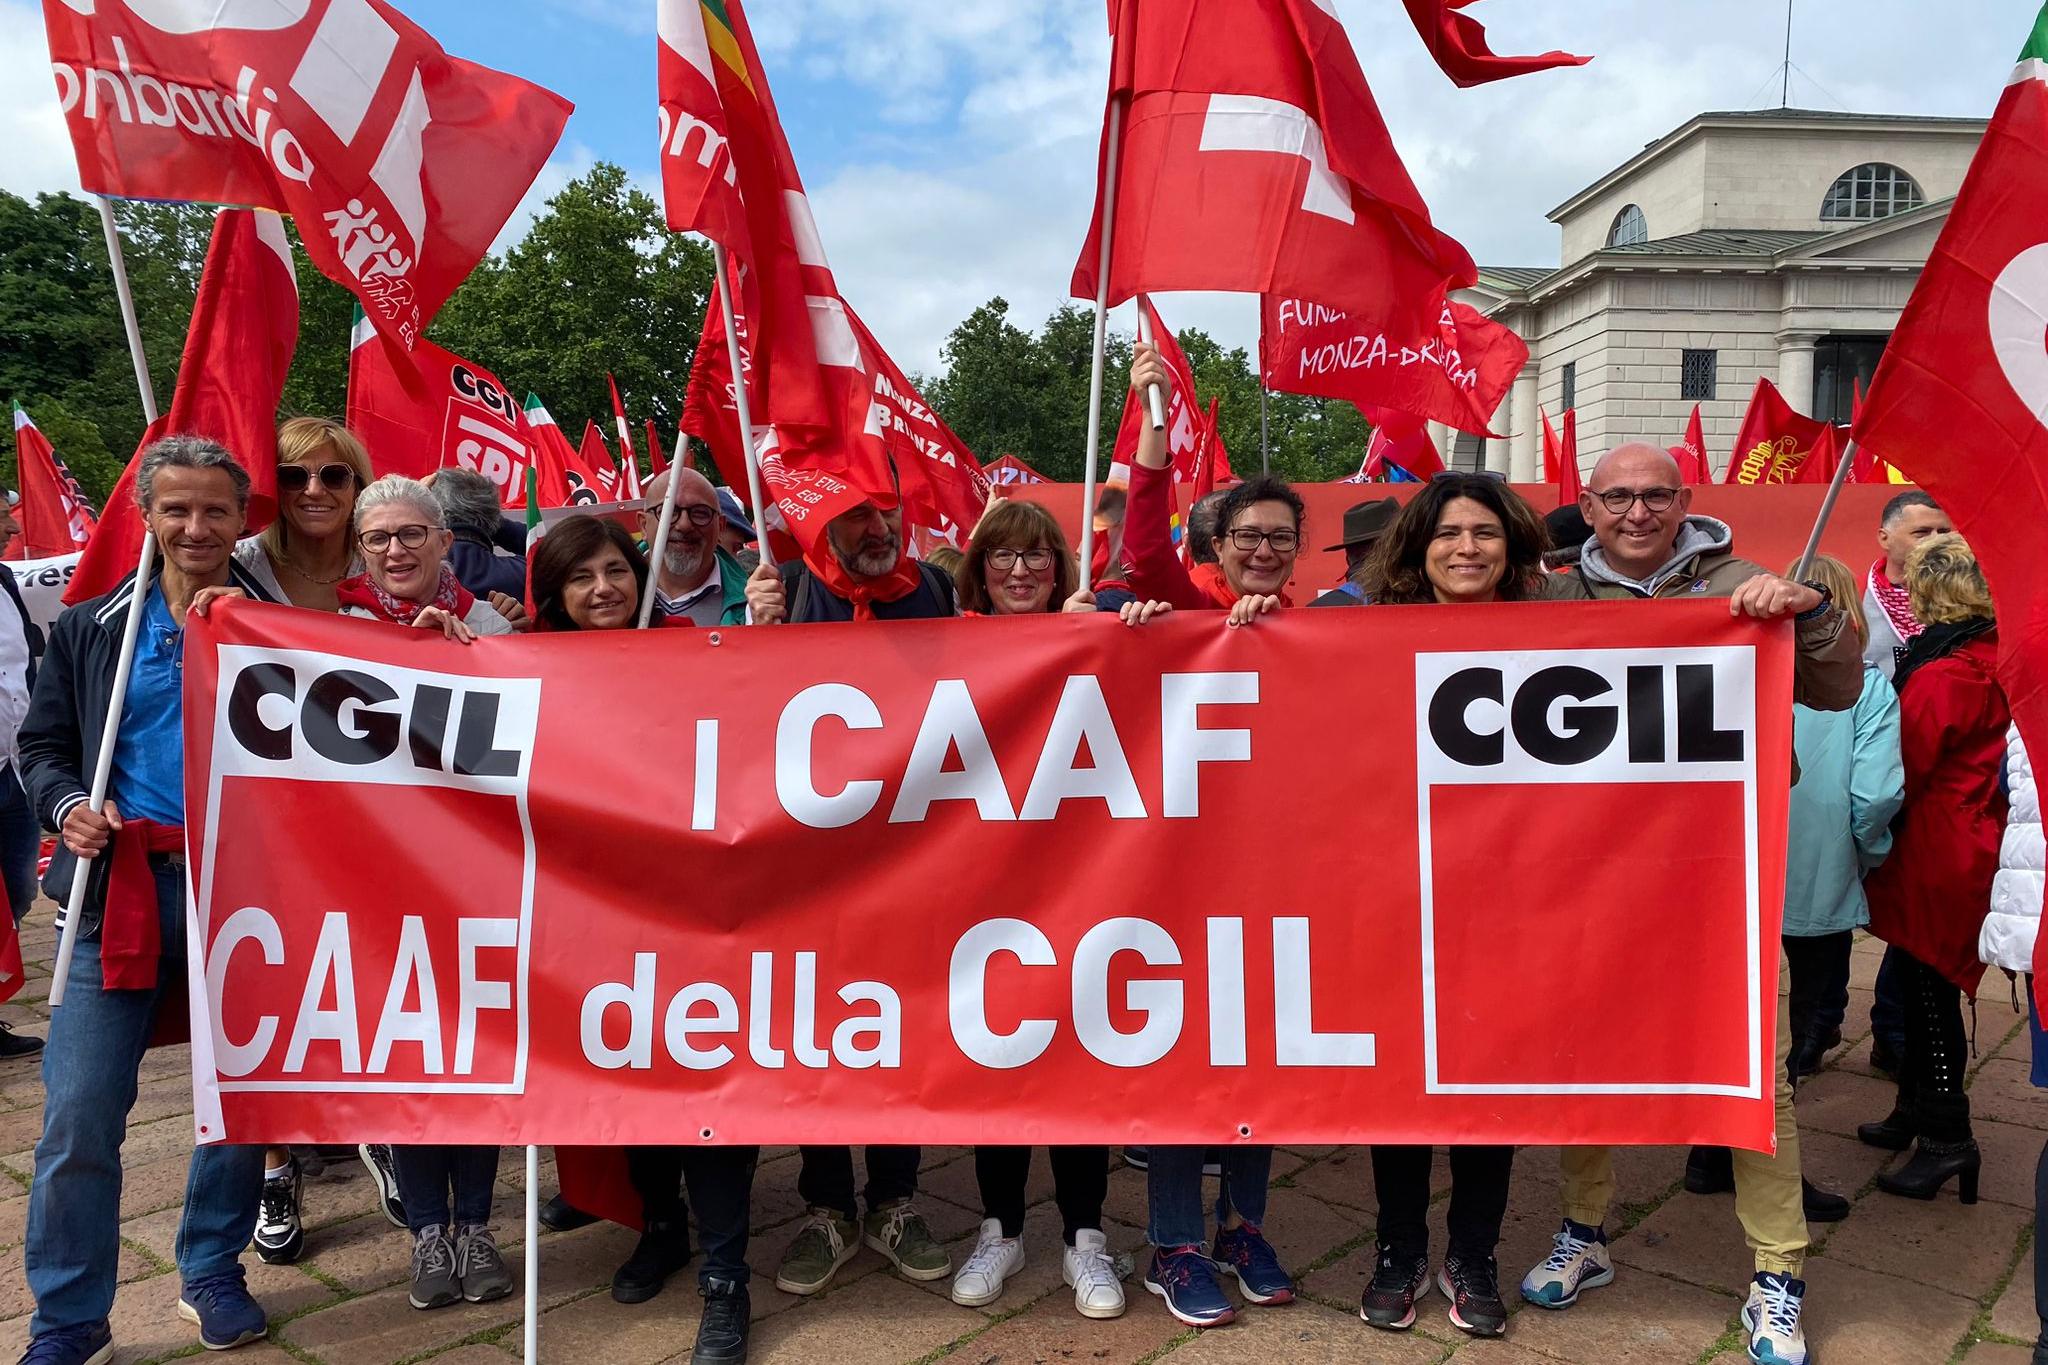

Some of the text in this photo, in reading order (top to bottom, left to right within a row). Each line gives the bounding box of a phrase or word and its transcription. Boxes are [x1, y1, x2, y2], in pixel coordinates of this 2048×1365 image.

[796, 489, 823, 504] EGB
[814, 476, 847, 494] ETUC
[227, 661, 523, 778] CGIL
[690, 671, 1260, 832] I CAAF
[1427, 663, 1745, 767] CGIL
[205, 906, 519, 1078] CAAF
[579, 915, 1376, 1070] della CGIL
